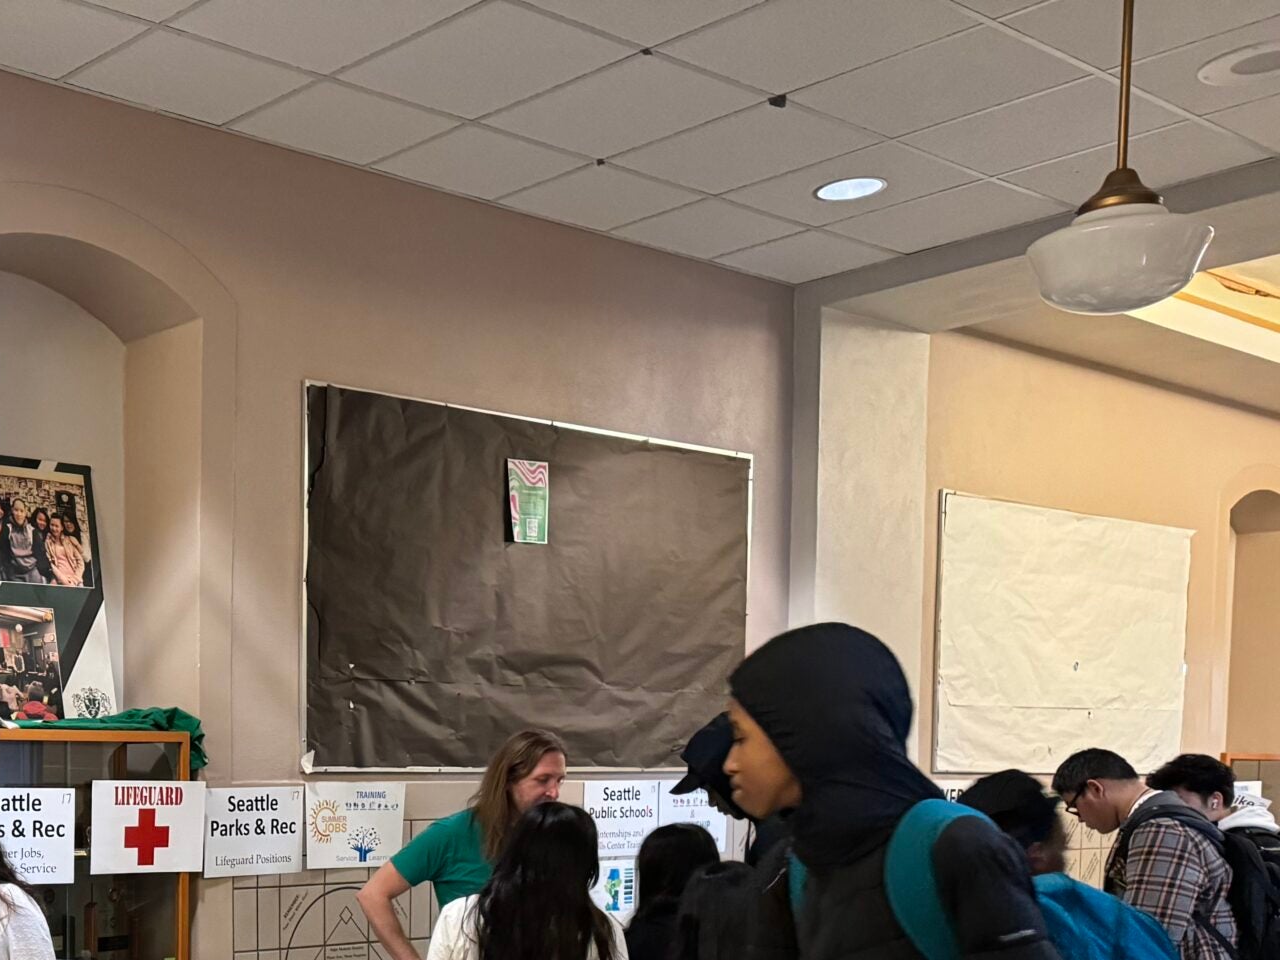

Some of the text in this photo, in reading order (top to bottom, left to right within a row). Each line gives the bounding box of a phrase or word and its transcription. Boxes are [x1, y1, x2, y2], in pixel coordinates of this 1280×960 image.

[114, 786, 183, 806] LIFEGUARD
[356, 791, 386, 799] TRAINING
[603, 786, 641, 801] Seattle
[228, 794, 279, 812] Seattle
[589, 805, 653, 819] Public Schools
[11, 820, 26, 838] &
[32, 820, 66, 838] Rec
[210, 818, 297, 837] Parks & Rec
[323, 823, 347, 833] JOBS
[598, 829, 632, 840] nternships
[20, 847, 45, 860] Jobs,
[215, 852, 292, 869] Lifeguard Positions
[20, 862, 57, 874] Service
